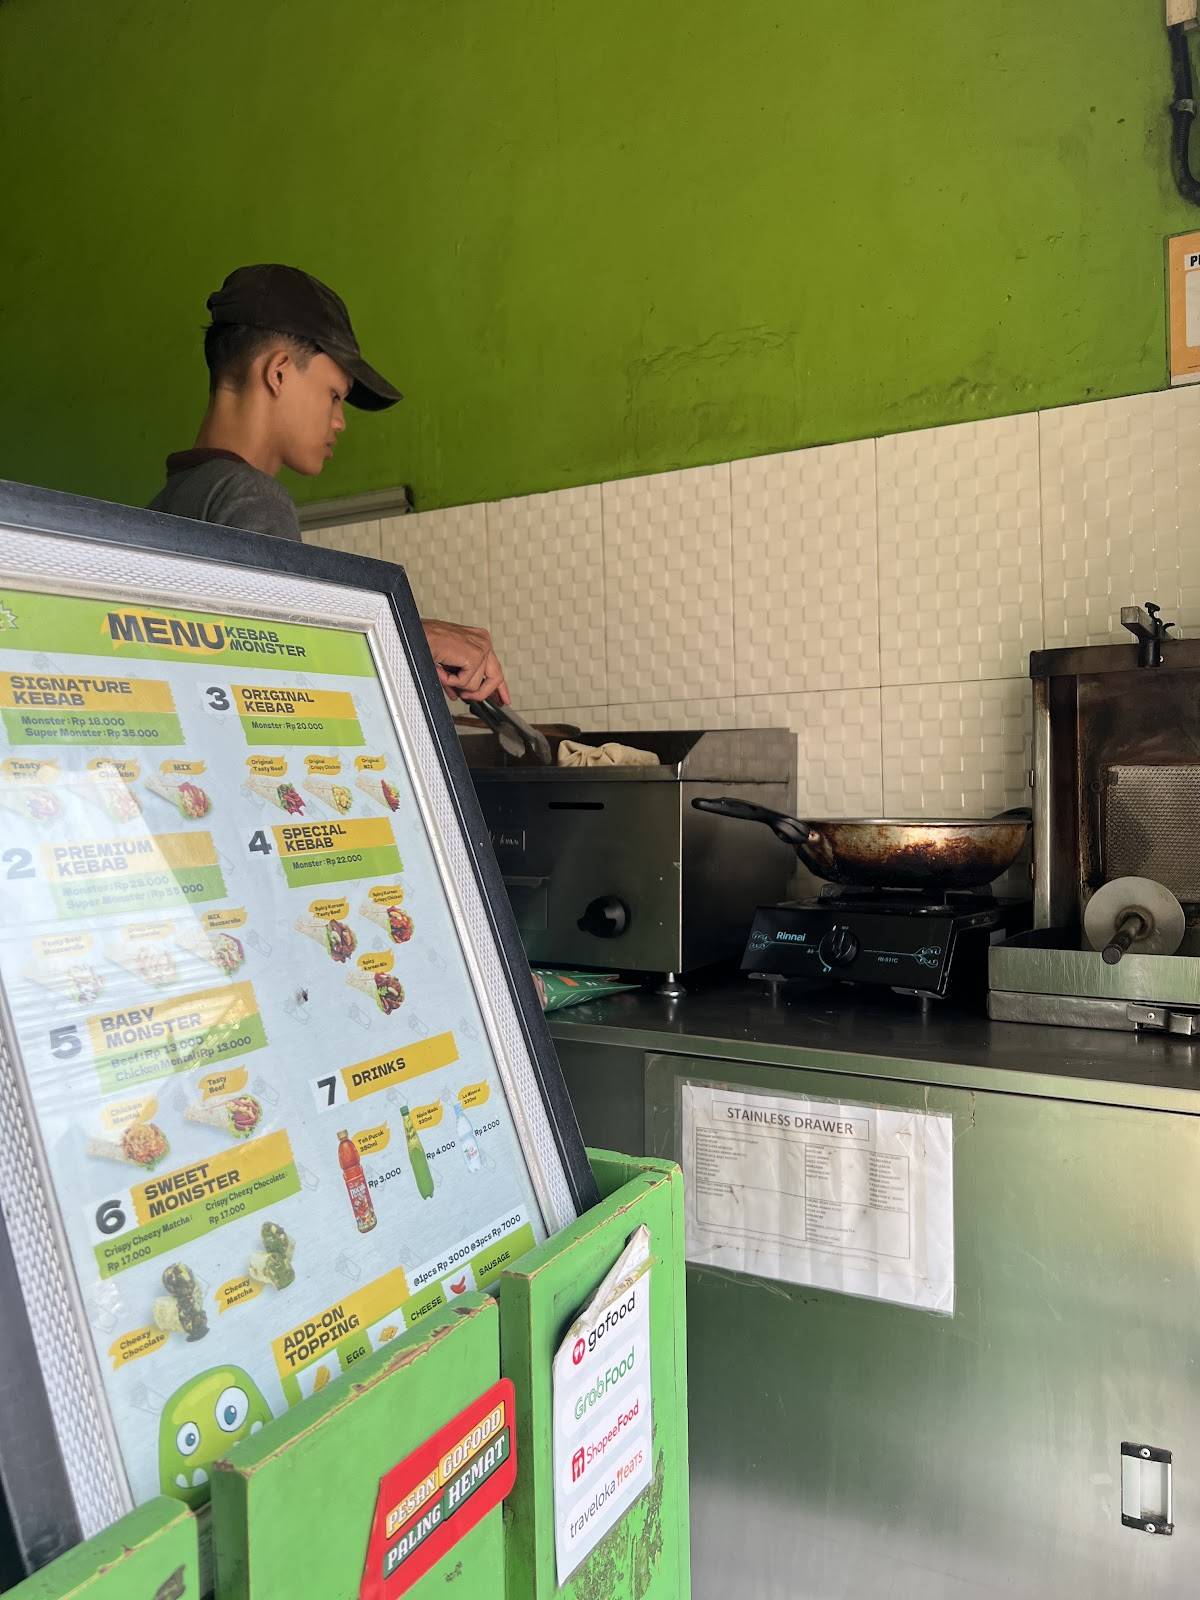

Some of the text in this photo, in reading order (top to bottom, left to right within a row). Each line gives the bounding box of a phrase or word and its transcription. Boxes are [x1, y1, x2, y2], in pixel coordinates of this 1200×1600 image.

[107, 613, 225, 650] MENU
[225, 626, 279, 643] KEBAB
[230, 640, 306, 657] MONSTER
[10, 675, 133, 694] SIGNATURE
[242, 689, 314, 703] ORIGINAL
[13, 690, 85, 706] KEBAB
[206, 687, 230, 711] 3
[245, 702, 295, 713] KEBAB
[25, 728, 57, 738] Super
[122, 728, 159, 738] 35.000
[11, 761, 41, 771] Tasty
[173, 763, 192, 771] MIX
[249, 830, 272, 855] 4
[282, 824, 347, 840] SPECIAL
[53, 839, 153, 862] PREMIUM
[285, 837, 334, 853] KEBAB
[2, 847, 36, 880] 2
[58, 858, 128, 877] KEBAB
[337, 855, 363, 865] 22.000
[776, 931, 807, 942] Rinnai
[100, 1007, 155, 1032] BABY
[105, 1012, 203, 1048] MONSTER
[49, 1024, 82, 1060] 5
[116, 1065, 160, 1081] Chicken
[217, 1036, 252, 1053] 13.000
[207, 1075, 227, 1087] Tasty
[352, 1057, 406, 1087] DRINKS
[208, 1083, 226, 1094] Beef
[317, 1075, 336, 1106] 7
[474, 1119, 500, 1137] Rp 2.000
[727, 1107, 853, 1136] STAINLESS DRAWER
[426, 1150, 436, 1160] Rp
[436, 1141, 456, 1156] 4.000
[144, 1163, 209, 1201] SWEET
[368, 1167, 402, 1188] Rp 3.000
[149, 1169, 241, 1218] MONSTER
[205, 1196, 229, 1211] Crispy
[229, 1185, 254, 1202] Cheezy
[95, 1199, 126, 1235] 6
[209, 1202, 246, 1225] Rp 17.000
[104, 1240, 132, 1258] Crispy
[132, 1228, 161, 1247] Cheezy
[437, 1260, 448, 1273] Rp
[449, 1246, 470, 1264] 3000
[492, 1227, 502, 1240] Rp
[502, 1214, 521, 1231] 7000
[107, 1246, 152, 1272] Rp 17.000
[478, 1250, 511, 1277] SAUSAGE
[224, 1279, 250, 1297] Cheezy
[226, 1287, 253, 1305] Matcha
[410, 1295, 443, 1322] CHEESE
[588, 1290, 636, 1352] gofood
[119, 1330, 151, 1350] Cheezy
[283, 1305, 345, 1354] ADD-ON
[285, 1314, 360, 1368] TOPPING
[122, 1332, 165, 1361] Chocolate
[346, 1346, 366, 1366] EGG
[575, 1344, 635, 1421] GrabFood
[586, 1398, 640, 1465] ShopeeFood
[387, 1407, 502, 1534] PESAN GOFOOD
[386, 1434, 506, 1571] PALING HEMAT
[570, 1479, 616, 1539] traveloka
